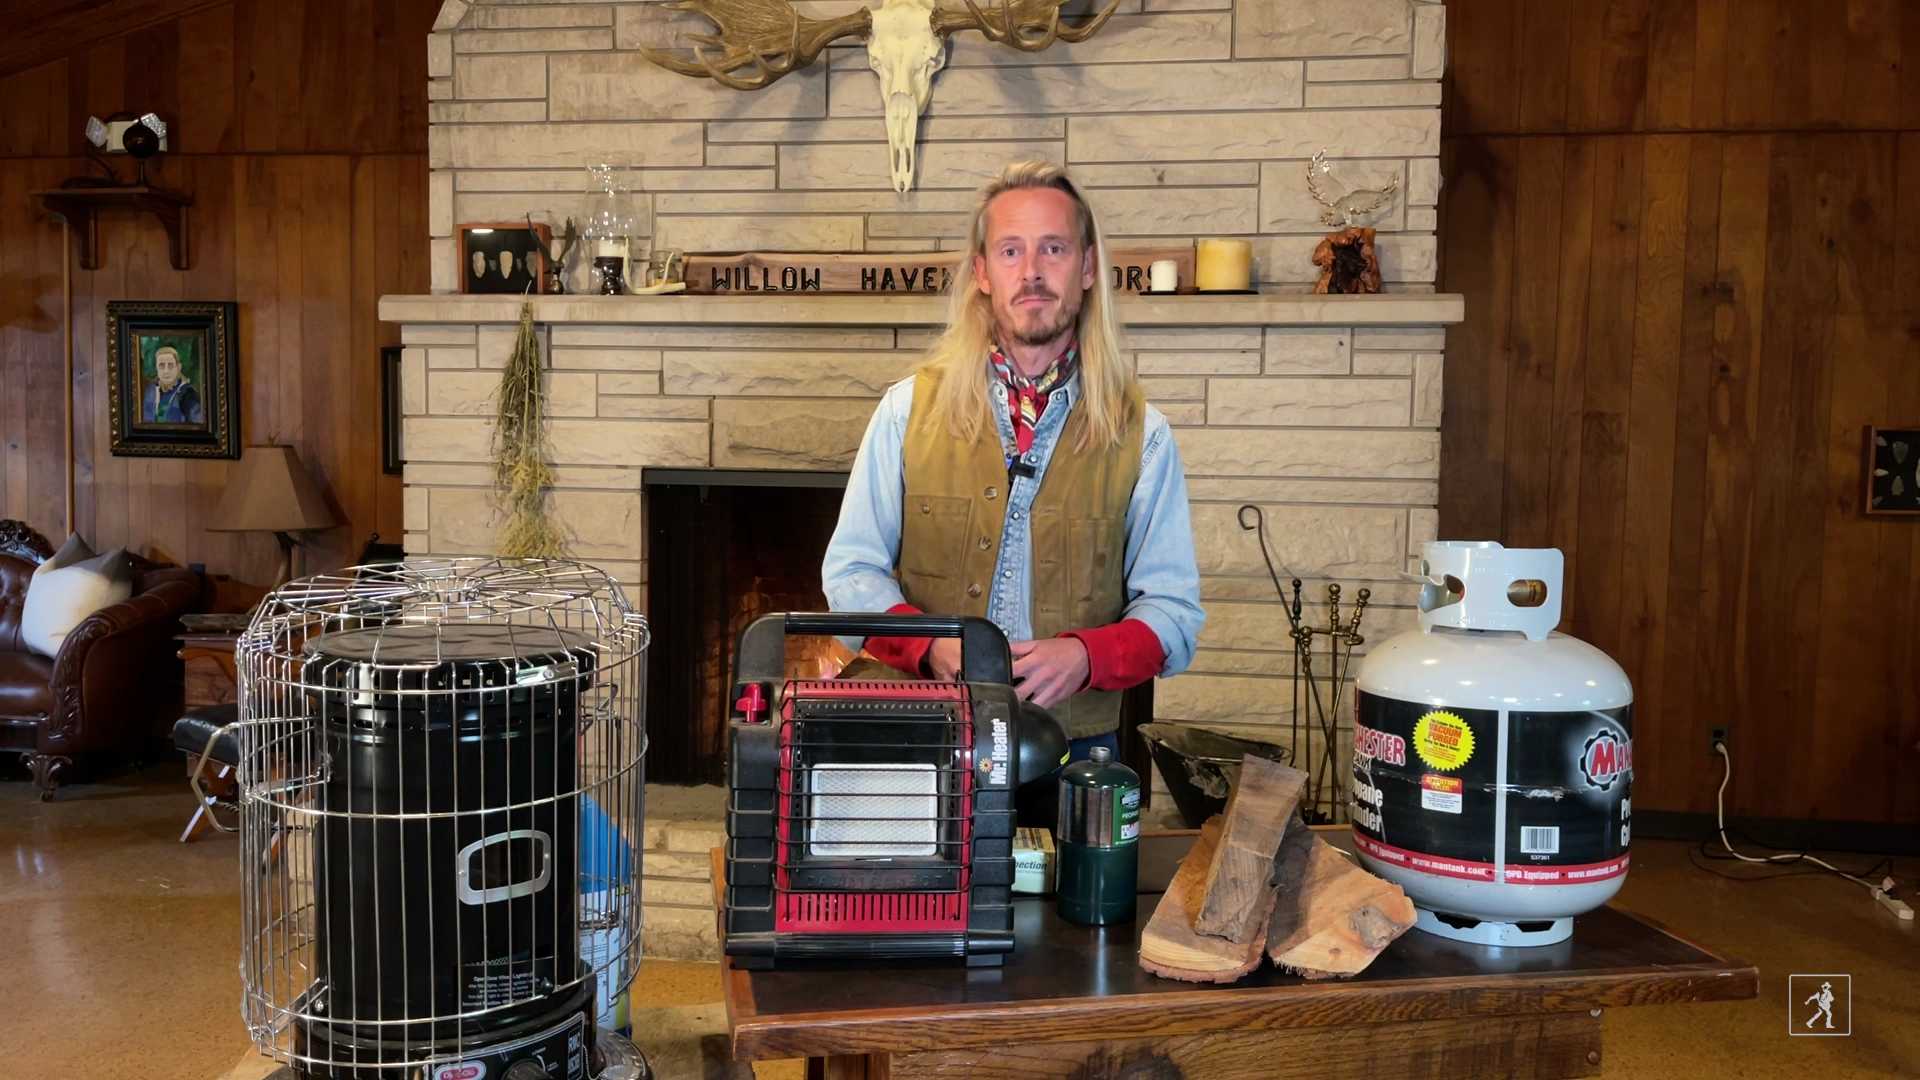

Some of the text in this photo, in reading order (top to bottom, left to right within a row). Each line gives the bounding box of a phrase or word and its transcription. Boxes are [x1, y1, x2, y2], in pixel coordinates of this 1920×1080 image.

[711, 266, 821, 292] WILLOW
[990, 718, 1008, 785] Mr. Heater
[1523, 870, 1559, 880] Equipped
